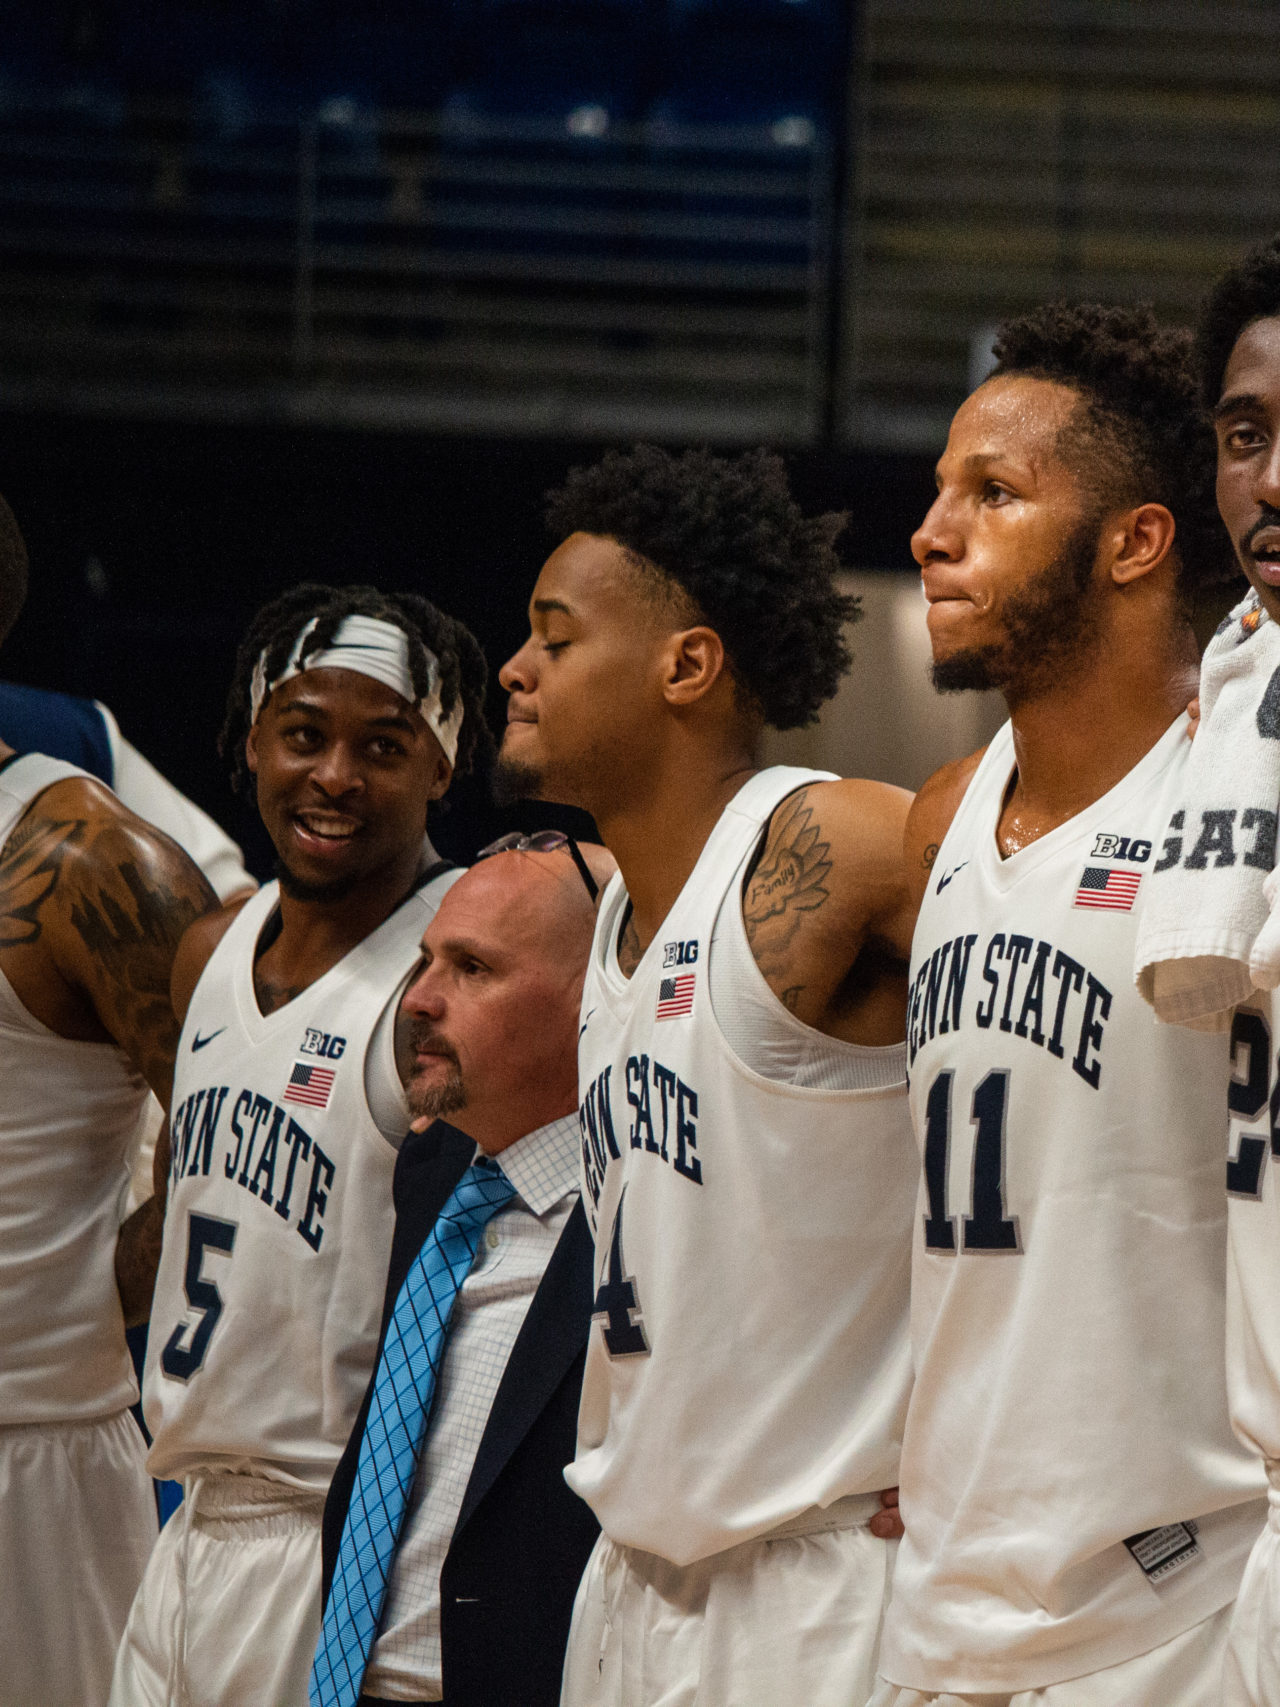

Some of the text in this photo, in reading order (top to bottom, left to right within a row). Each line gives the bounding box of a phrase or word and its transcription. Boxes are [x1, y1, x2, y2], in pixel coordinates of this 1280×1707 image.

[976, 933, 1114, 1091] STATE
[225, 1087, 337, 1254] STATE
[922, 1067, 1024, 1256] 11
[160, 1209, 240, 1386] 5
